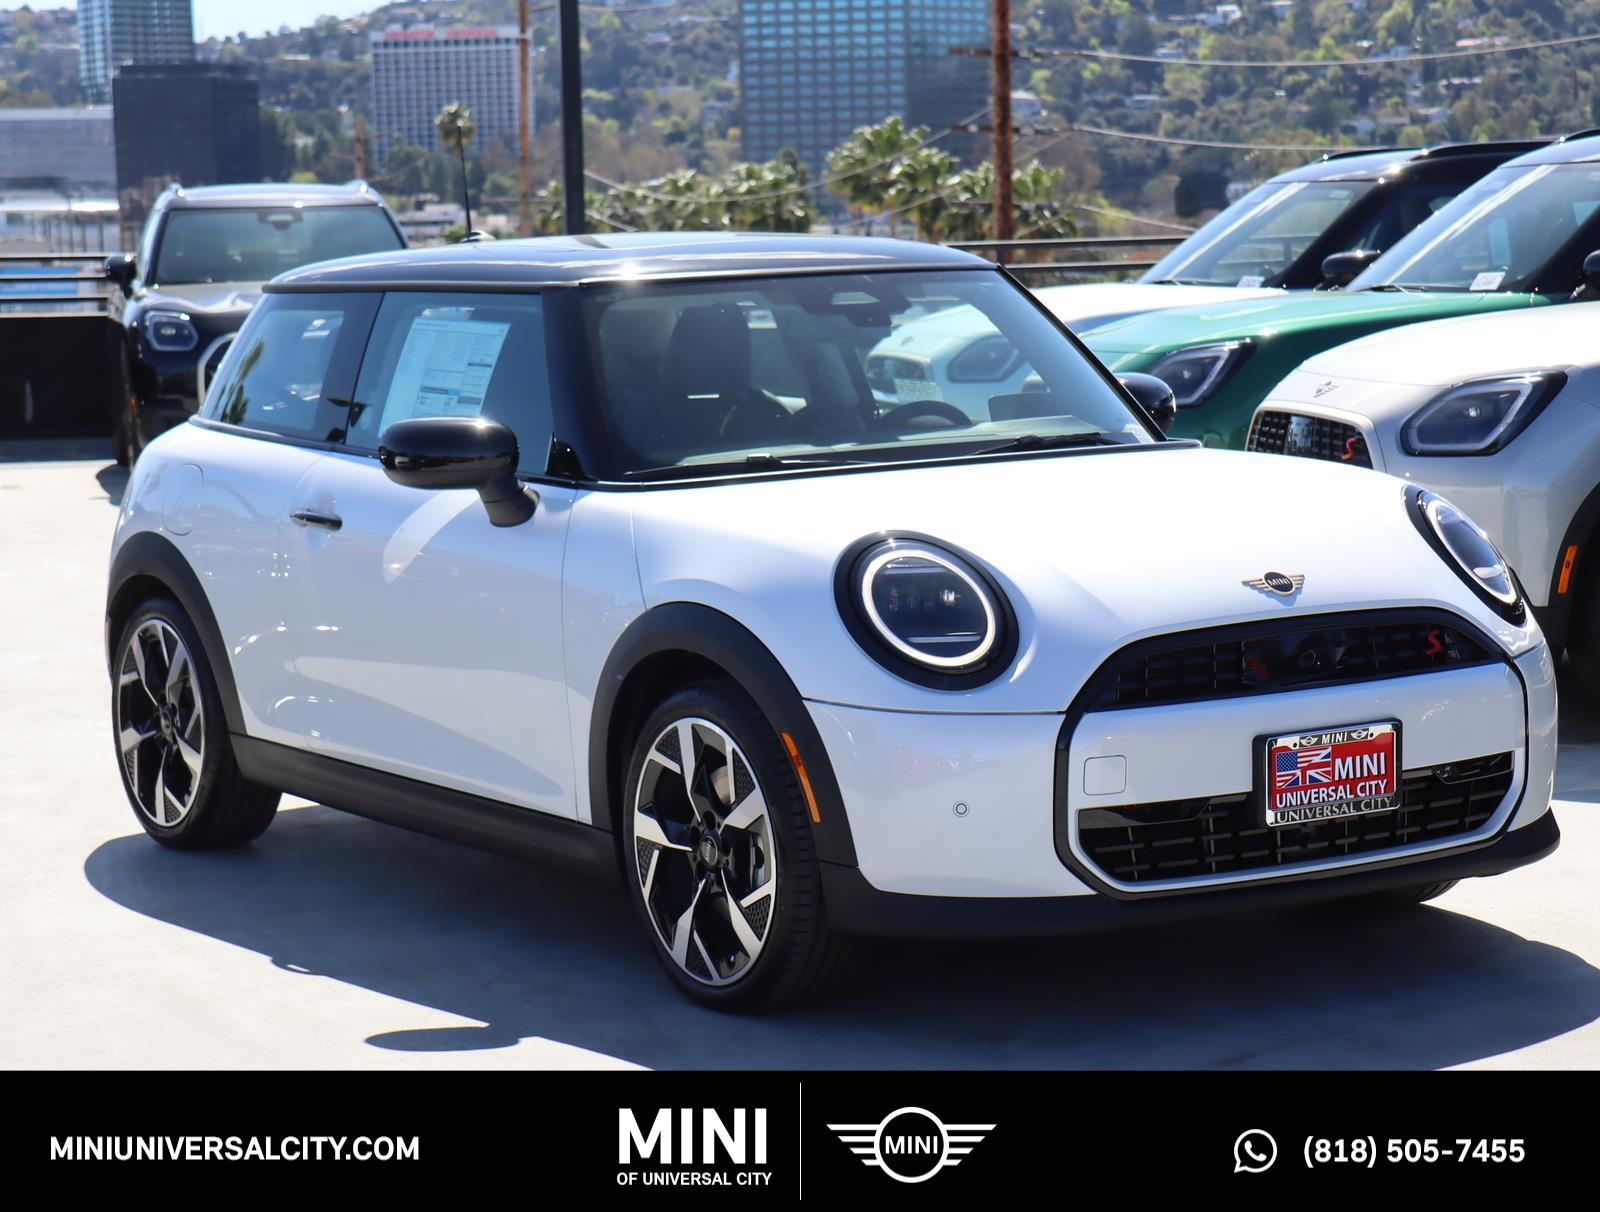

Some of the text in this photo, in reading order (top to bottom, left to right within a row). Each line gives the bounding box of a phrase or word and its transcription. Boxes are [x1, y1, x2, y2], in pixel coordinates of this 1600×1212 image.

[1267, 577, 1291, 586] MINI
[1425, 629, 1441, 656] S
[1322, 732, 1348, 745] MINI
[1334, 752, 1386, 781] MINI
[1276, 779, 1388, 808] UNIVERSAL CITY
[1277, 797, 1393, 823] UNIVERSAL CITY
